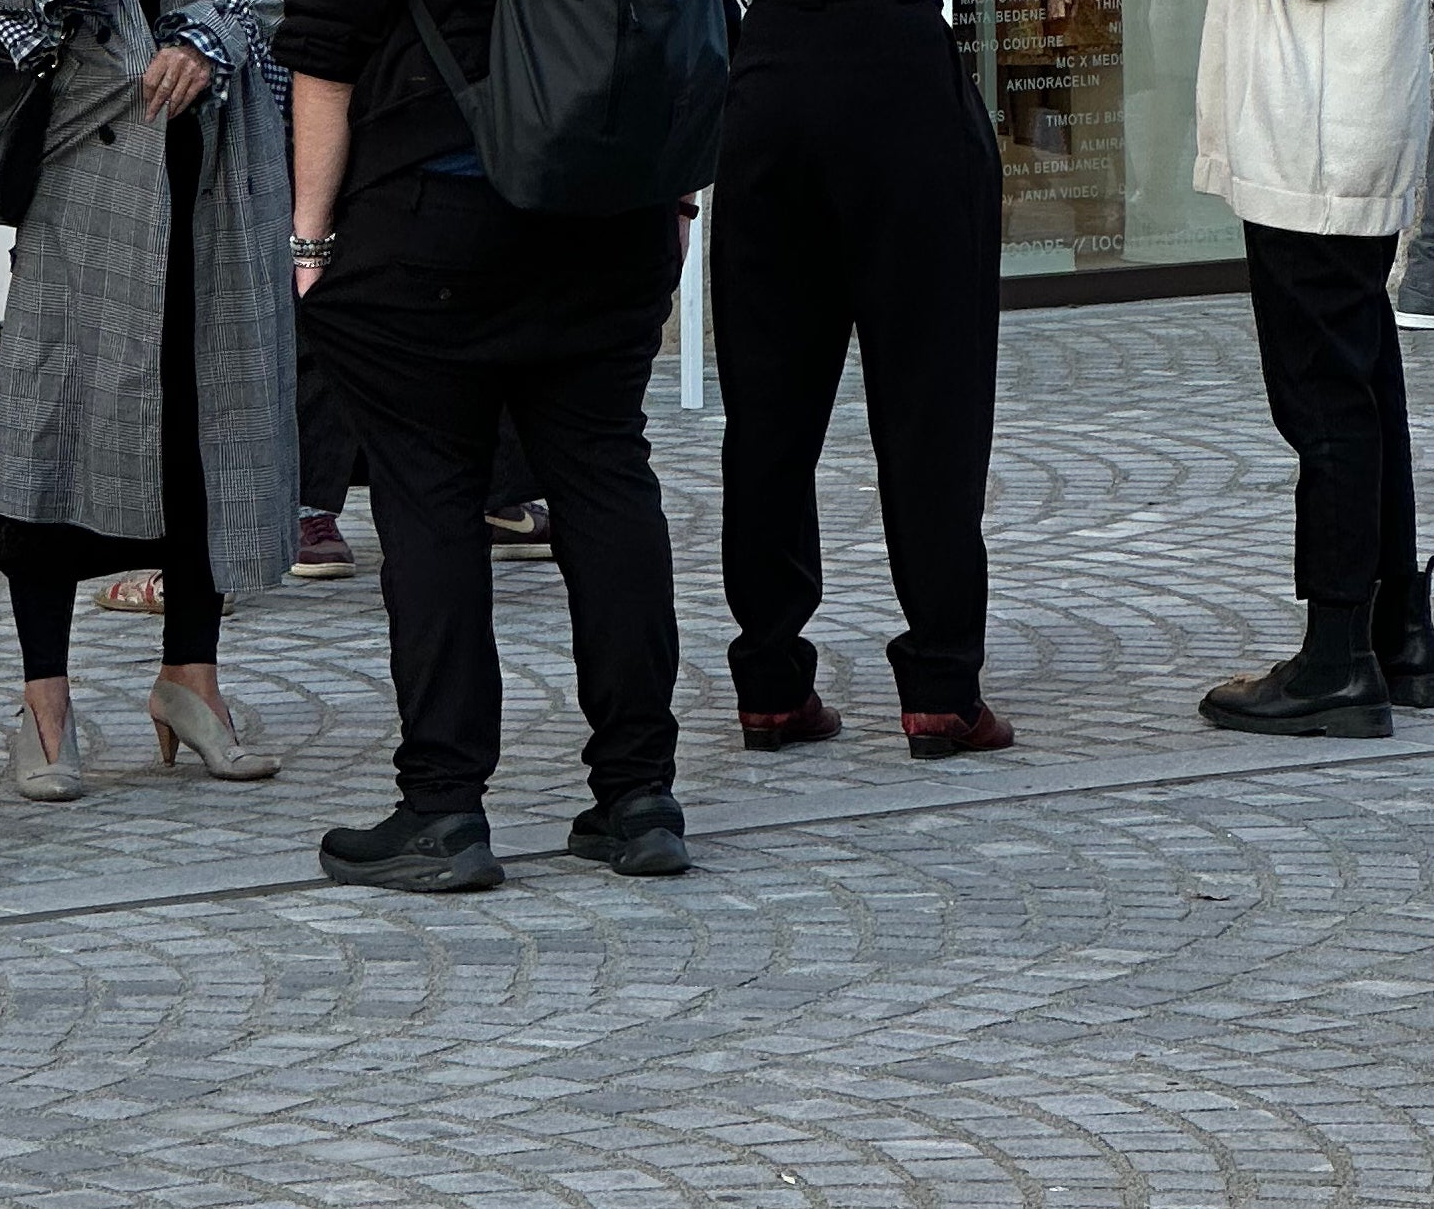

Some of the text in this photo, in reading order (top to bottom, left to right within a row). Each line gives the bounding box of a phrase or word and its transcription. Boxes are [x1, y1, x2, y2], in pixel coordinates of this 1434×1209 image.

[952, 8, 1047, 26] ENATA BEDENE
[1003, 35, 1064, 51] COUTURE
[1056, 55, 1076, 69] MC
[1006, 74, 1100, 91] AKINORACELIN
[1046, 112, 1100, 127] TIMOTEJ
[1002, 162, 1030, 176] ONA
[1018, 188, 1057, 203] JANJA
